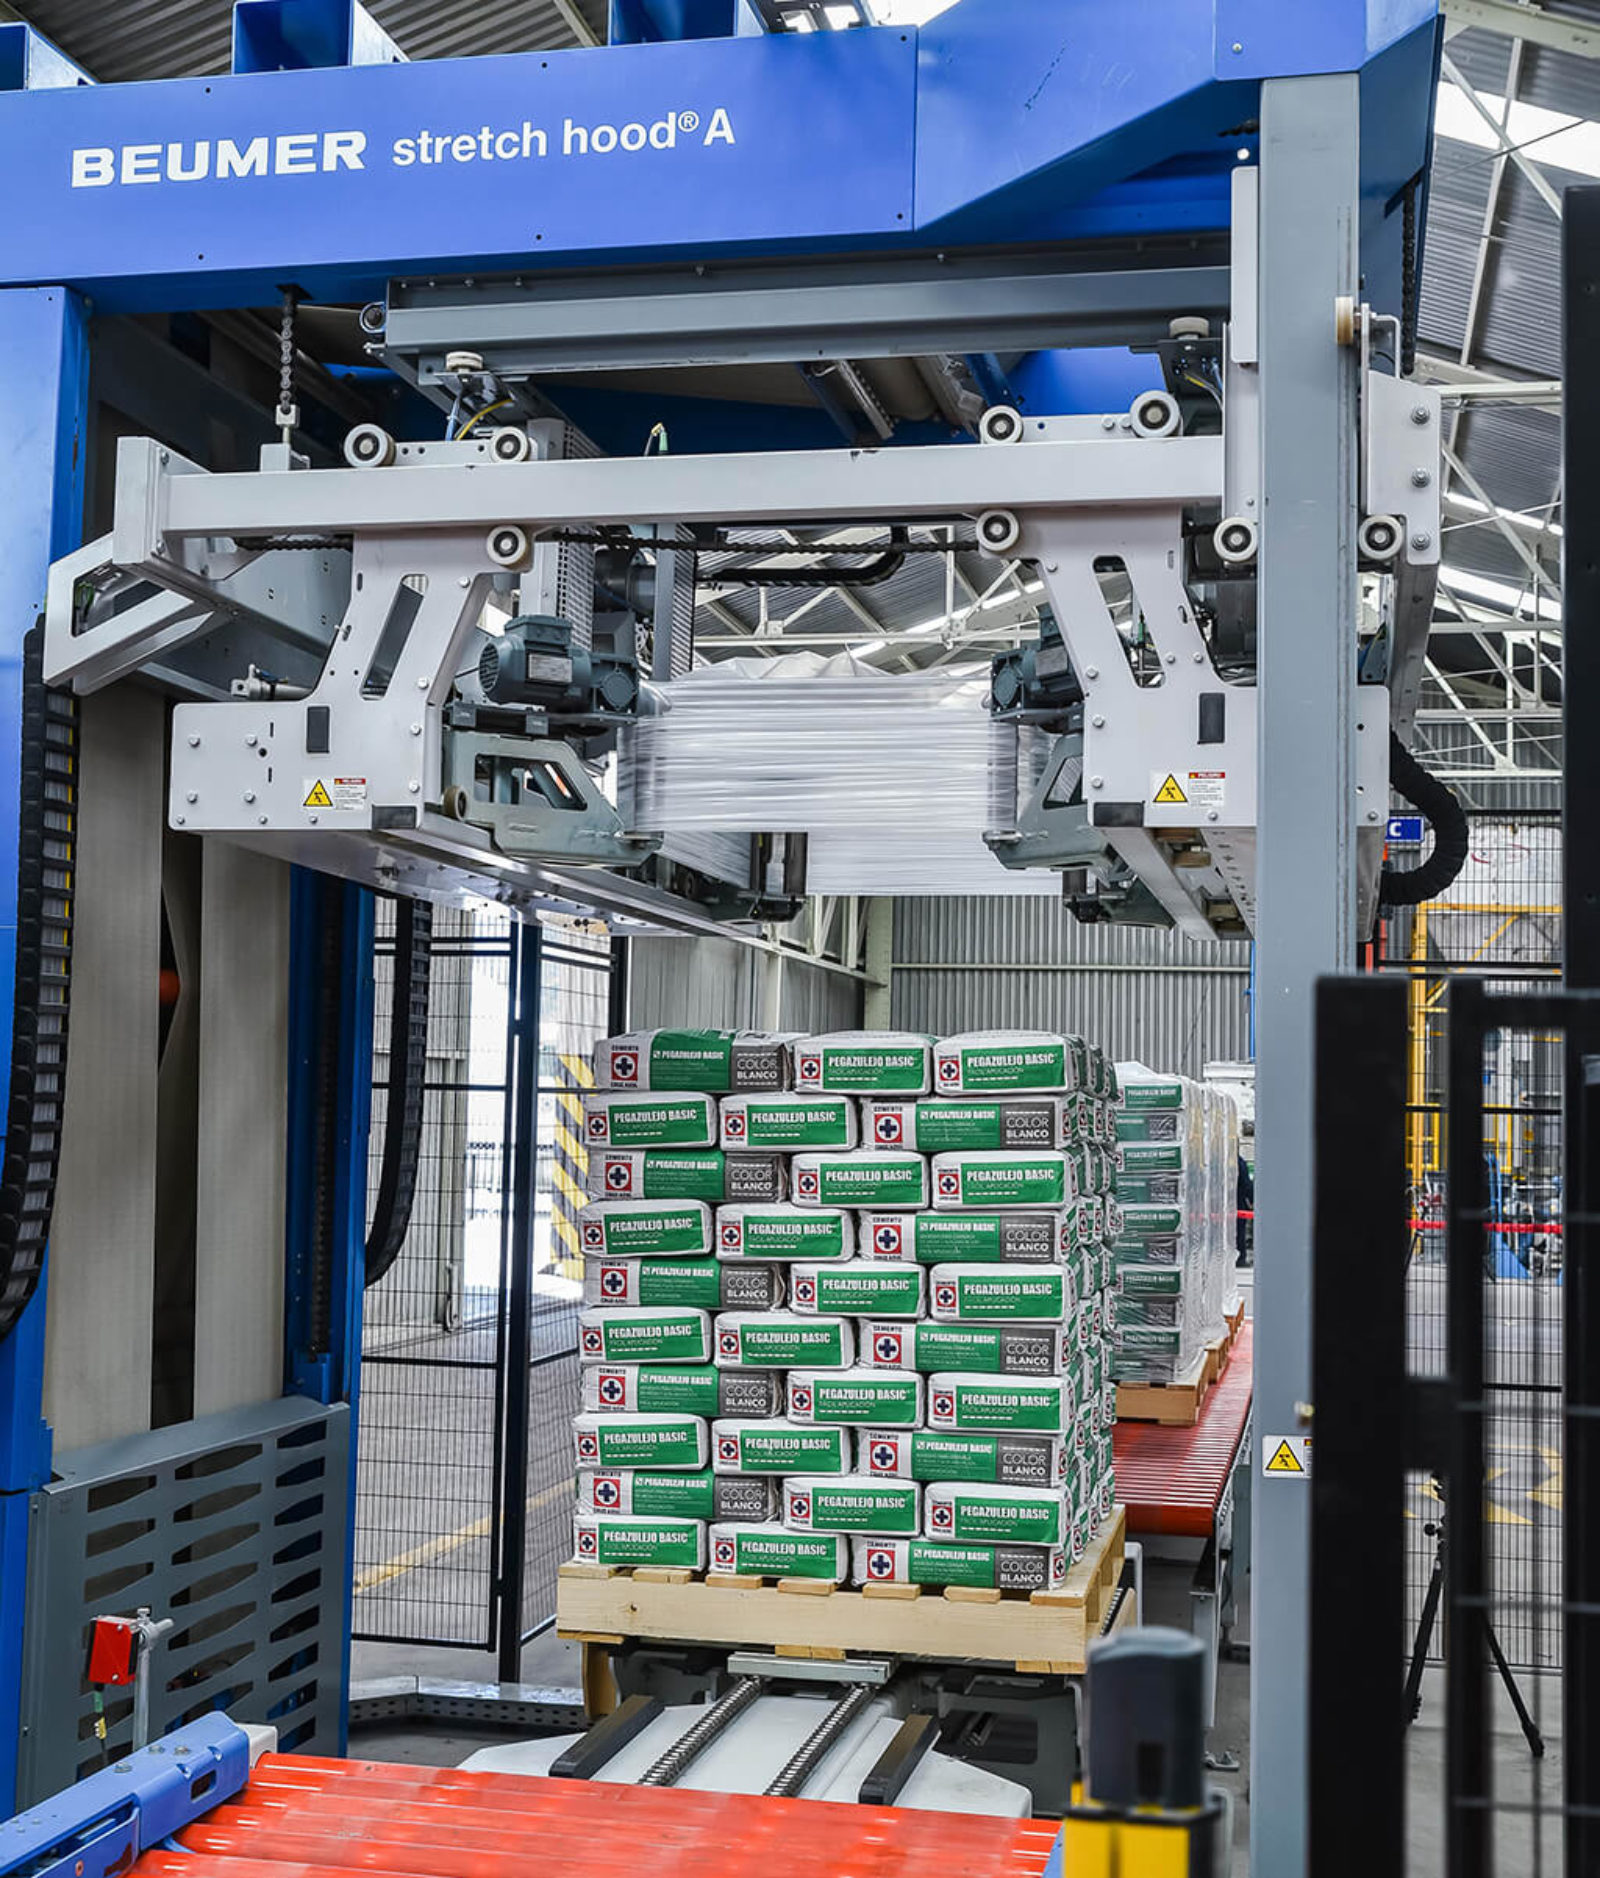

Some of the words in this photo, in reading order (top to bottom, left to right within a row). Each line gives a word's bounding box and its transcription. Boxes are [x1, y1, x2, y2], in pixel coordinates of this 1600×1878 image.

[71, 129, 366, 188] BEUMER
[392, 117, 548, 168] stretch
[703, 107, 735, 146] A
[737, 1059, 777, 1070] COLOR
[829, 1056, 883, 1067] PEGAZULEJO
[886, 1056, 914, 1066] BASIC
[967, 1055, 1023, 1067] PEGAZULEJO
[1025, 1054, 1054, 1064] BASIC
[737, 1071, 777, 1080] BLANCO
[614, 1111, 667, 1122] PEGAZULEJO
[669, 1109, 696, 1120] BASIC
[752, 1112, 805, 1123] PEGAZULEJO
[807, 1111, 836, 1122] BASIC
[1007, 1117, 1049, 1128] COLOR
[1007, 1129, 1049, 1138] BLANCO
[731, 1170, 772, 1181] COLOR
[826, 1170, 881, 1181] PEGAZULEJO
[883, 1170, 912, 1180] BASIC
[967, 1170, 1022, 1181] PEGAZULEJO
[1025, 1169, 1055, 1180] BASIC
[731, 1182, 772, 1190] BLANCO
[610, 1220, 662, 1232] PEGAZULEJO
[664, 1219, 693, 1229] BASIC
[749, 1224, 800, 1234] PEGAZULEJO
[802, 1224, 831, 1234] BASIC
[1006, 1231, 1049, 1241] COLOR
[1006, 1242, 1049, 1251] BLANCO
[727, 1277, 767, 1288] COLOR
[823, 1280, 878, 1290] PEGAZULEJO
[880, 1280, 909, 1290] BASIC
[727, 1289, 767, 1298] BLANCO
[964, 1284, 1020, 1295] PEGAZULEJO
[1022, 1284, 1052, 1294] BASIC
[609, 1326, 661, 1338] PEGAZULEJO
[663, 1325, 691, 1336] BASIC
[746, 1332, 800, 1343] PEGAZULEJO
[802, 1333, 830, 1343] BASIC
[1006, 1343, 1049, 1354] COLOR
[1006, 1356, 1049, 1365] BLANCO
[726, 1386, 766, 1397] COLOR
[820, 1389, 874, 1400] PEGAZULEJO
[877, 1389, 906, 1400] BASIC
[726, 1398, 766, 1407] BLANCO
[962, 1395, 1017, 1406] PEGAZULEJO
[1020, 1395, 1051, 1406] BASIC
[604, 1433, 657, 1444] PEGAZULEJO
[659, 1431, 687, 1441] BASIC
[746, 1438, 799, 1449] PEGAZULEJO
[801, 1439, 830, 1449] BASIC
[1003, 1453, 1046, 1465] COLOR
[1003, 1466, 1046, 1475] BLANCO
[721, 1488, 762, 1500] COLOR
[721, 1501, 762, 1510] BLANCO
[818, 1497, 874, 1508] PEGAZULEJO
[876, 1498, 905, 1508] BASIC
[960, 1506, 1016, 1519] PEGAZULEJO
[1019, 1508, 1049, 1520] BASIC
[604, 1532, 658, 1543] PEGAZULEJO
[660, 1532, 688, 1543] BASIC
[742, 1542, 796, 1555] PEGAZULEJO
[798, 1544, 826, 1555] BASIC
[1000, 1561, 1044, 1572] COLOR
[1000, 1574, 1043, 1583] BLANCO
